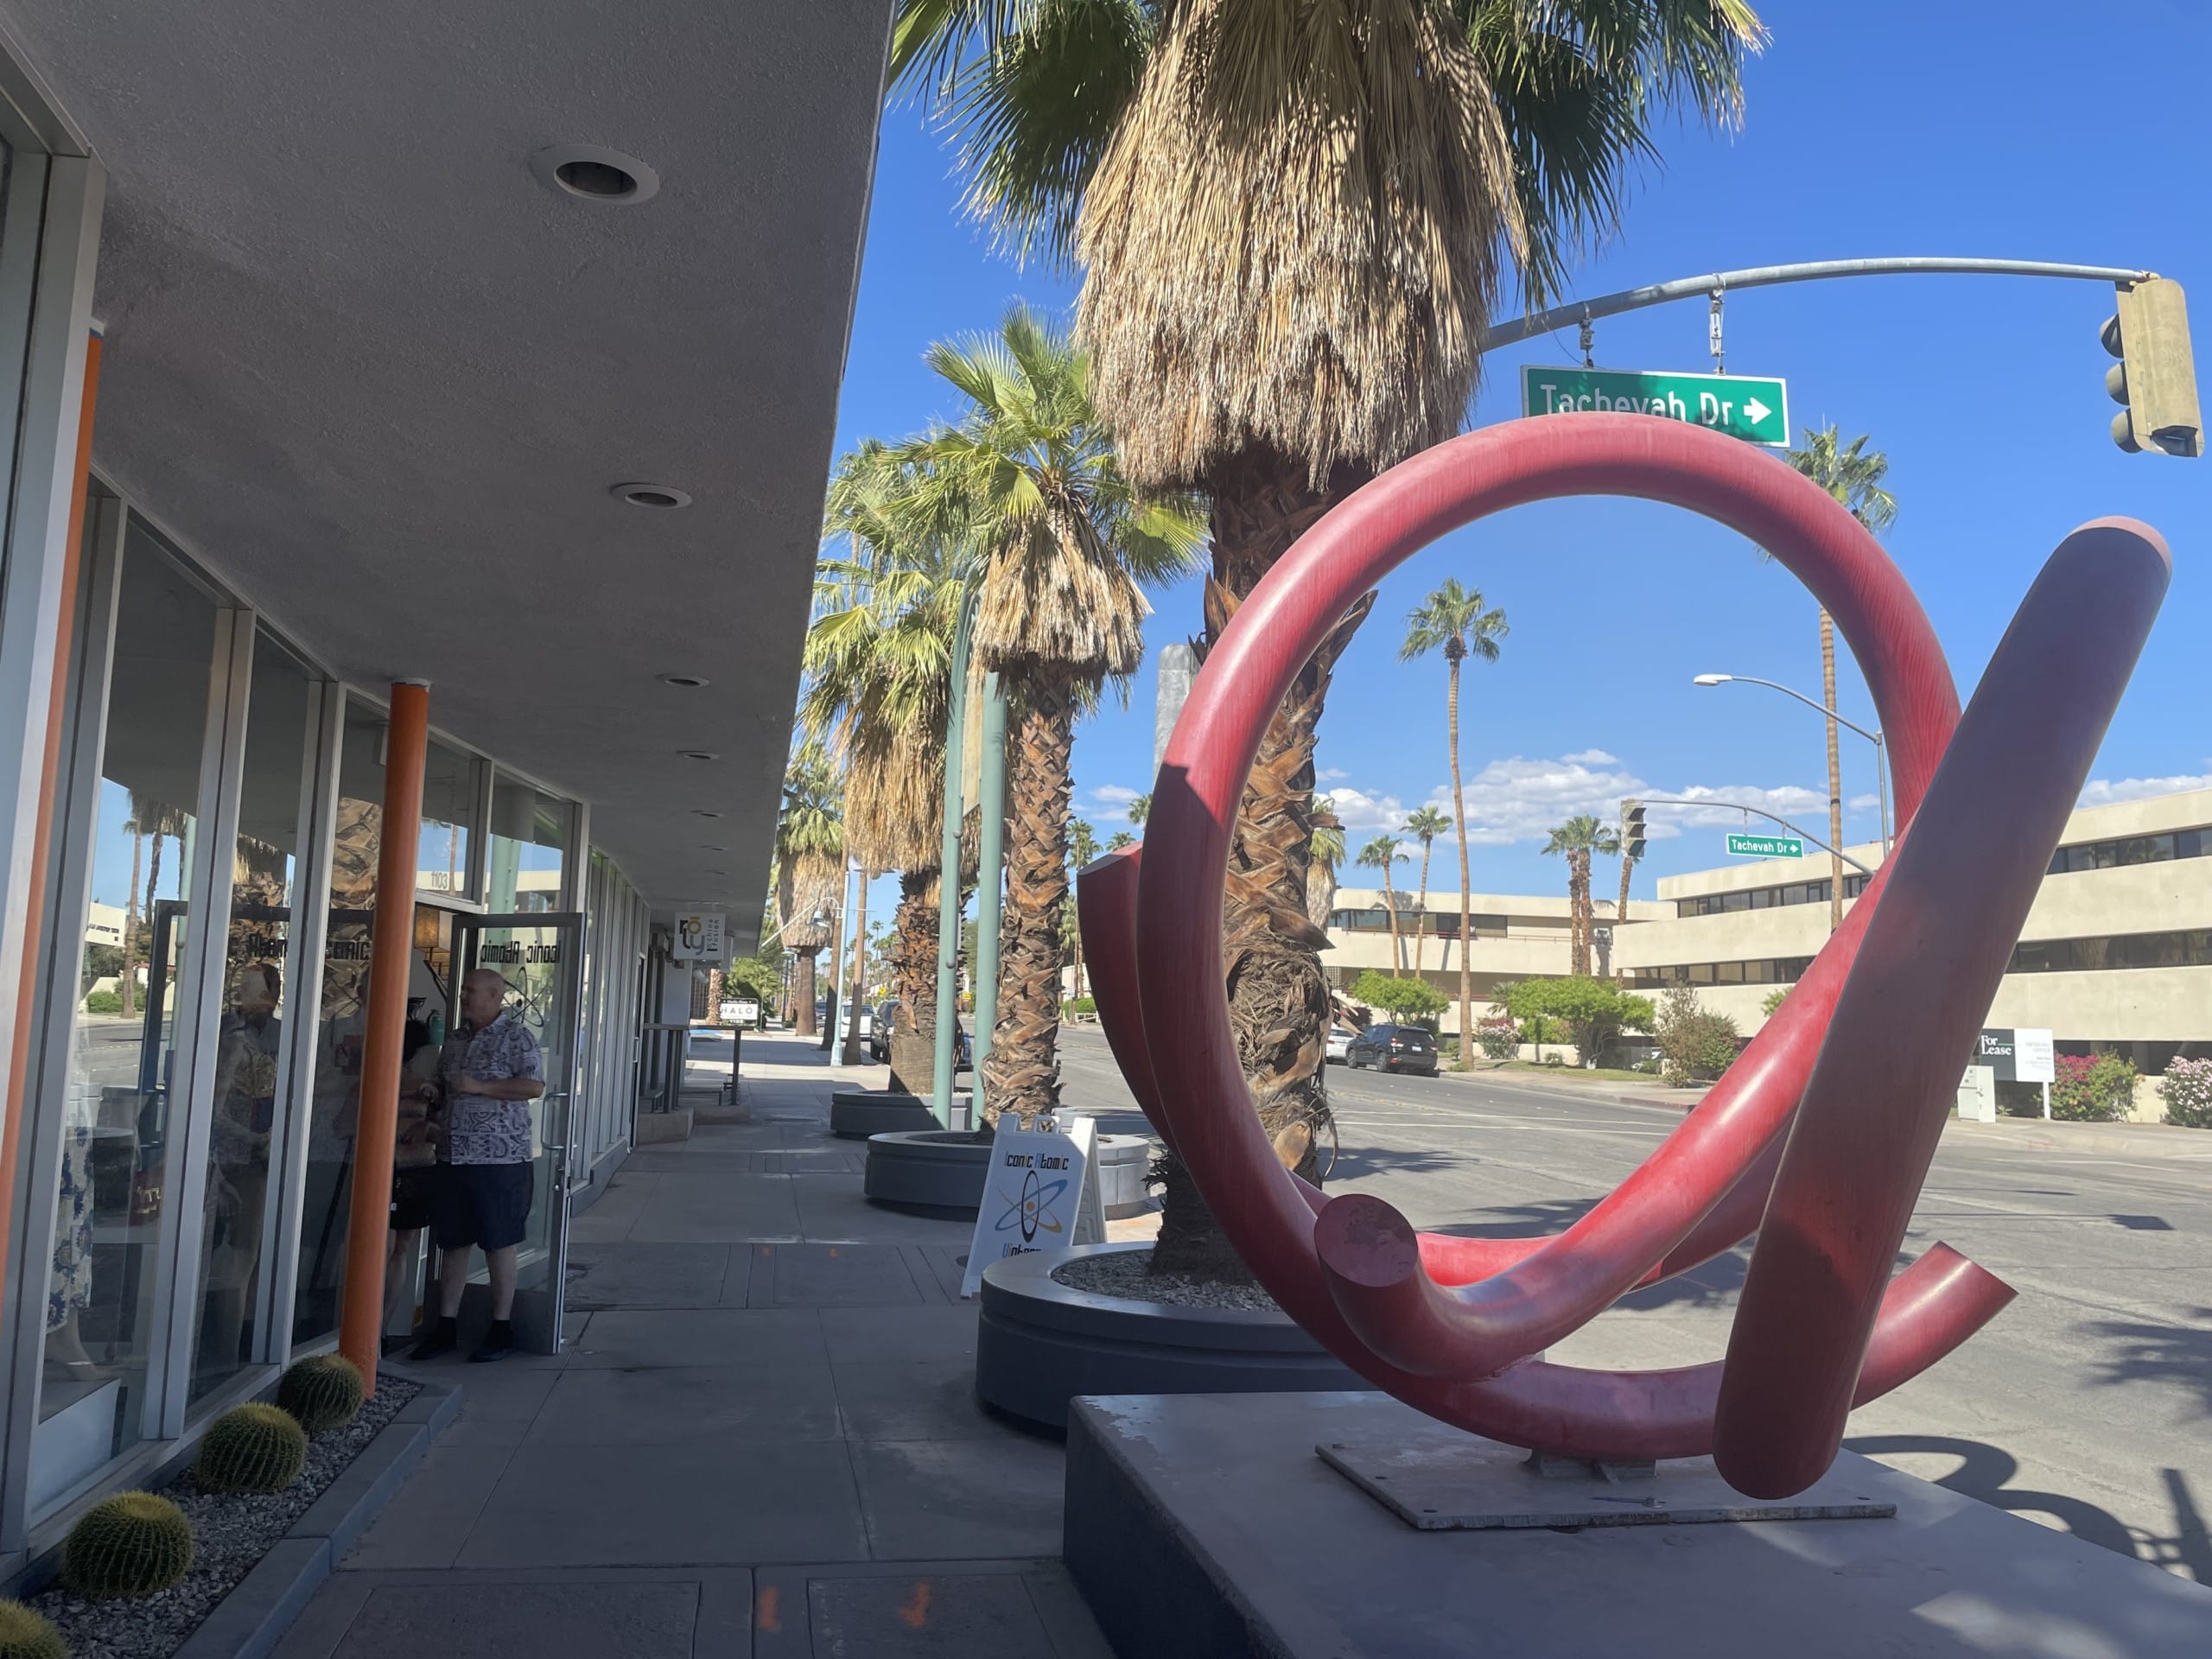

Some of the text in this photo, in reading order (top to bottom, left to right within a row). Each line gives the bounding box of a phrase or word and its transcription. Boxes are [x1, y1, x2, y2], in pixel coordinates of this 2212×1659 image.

[1541, 385, 1732, 425] Tachevah Dr
[1732, 839, 1787, 853] Tachevah Dr
[431, 871, 448, 889] 1103
[1980, 1035, 1998, 1046] For
[1981, 1045, 2012, 1055] Lease
[1004, 1151, 1069, 1170] Iconic Atomic
